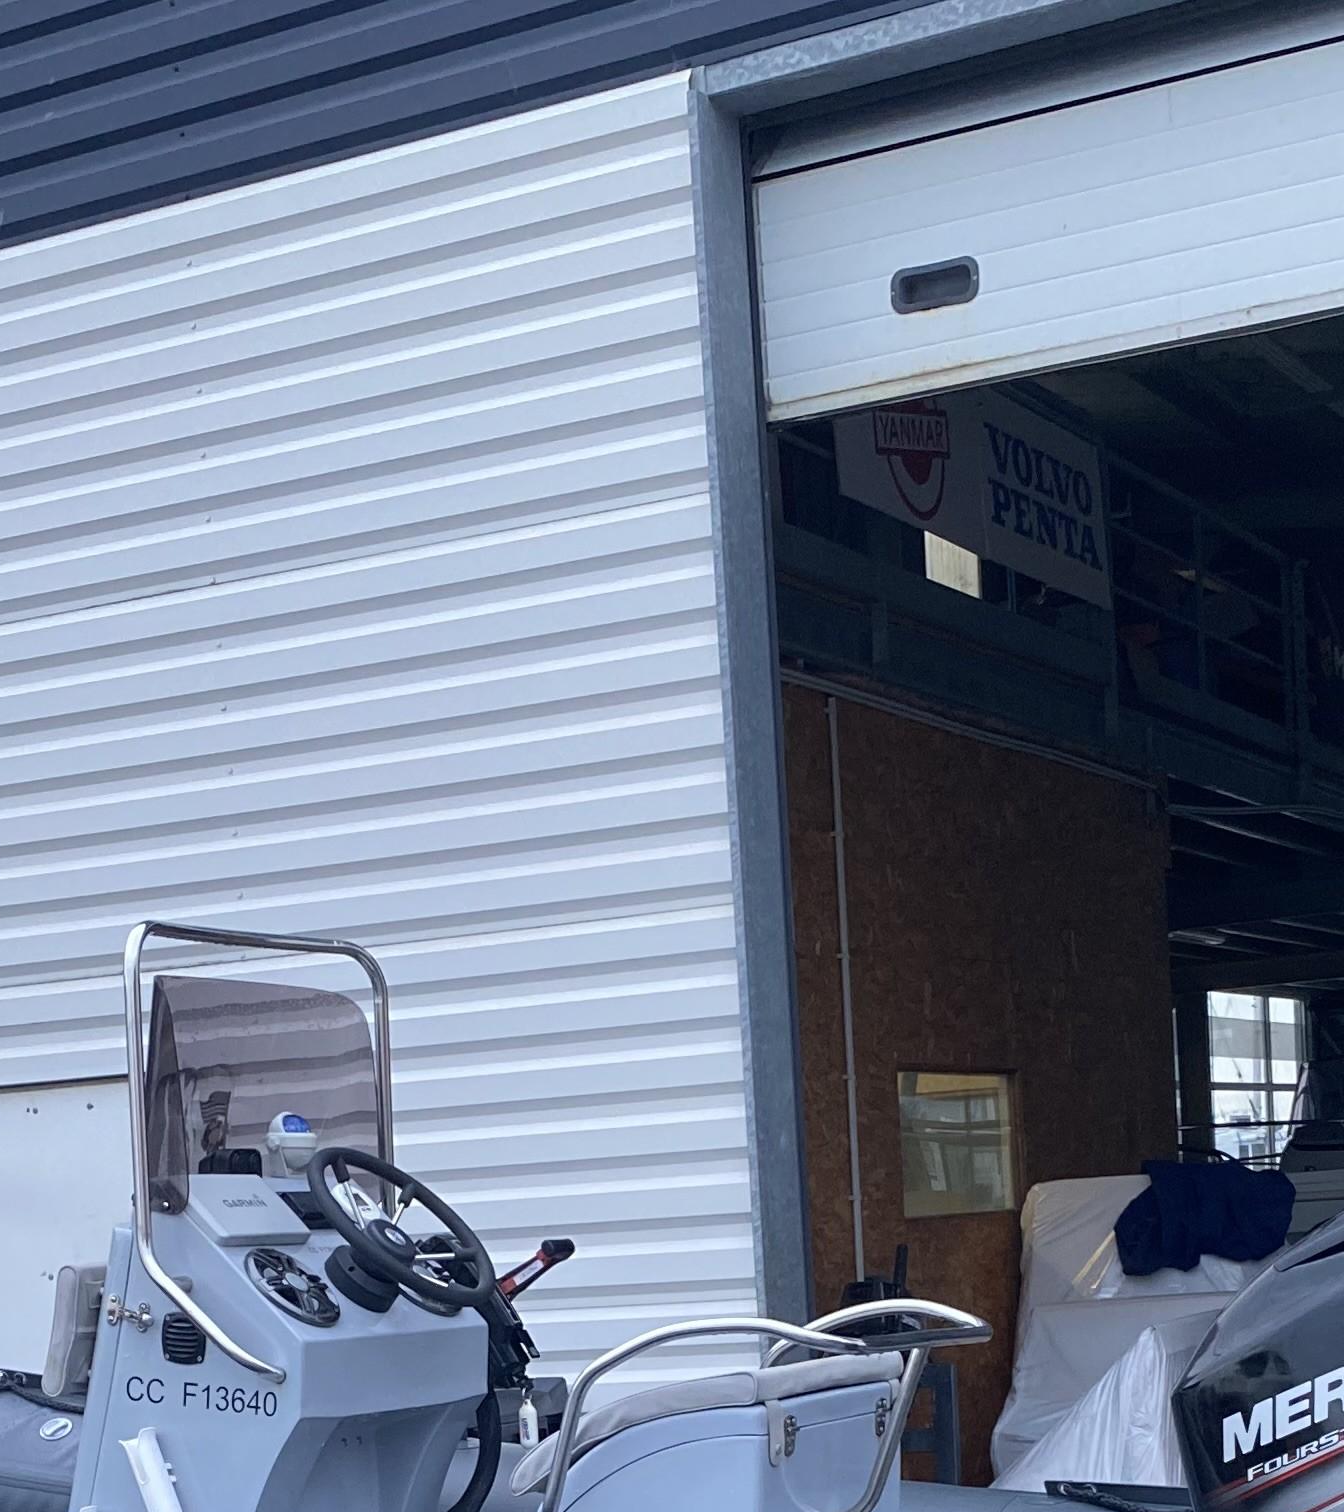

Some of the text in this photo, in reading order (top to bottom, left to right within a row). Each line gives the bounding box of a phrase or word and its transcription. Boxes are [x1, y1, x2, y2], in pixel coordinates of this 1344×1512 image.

[879, 413, 944, 449] YANMAR
[983, 422, 1094, 516] VOLVO
[988, 479, 1104, 570] PENTA
[222, 1198, 268, 1209] GARMIN
[126, 1376, 278, 1417] CC F13640
